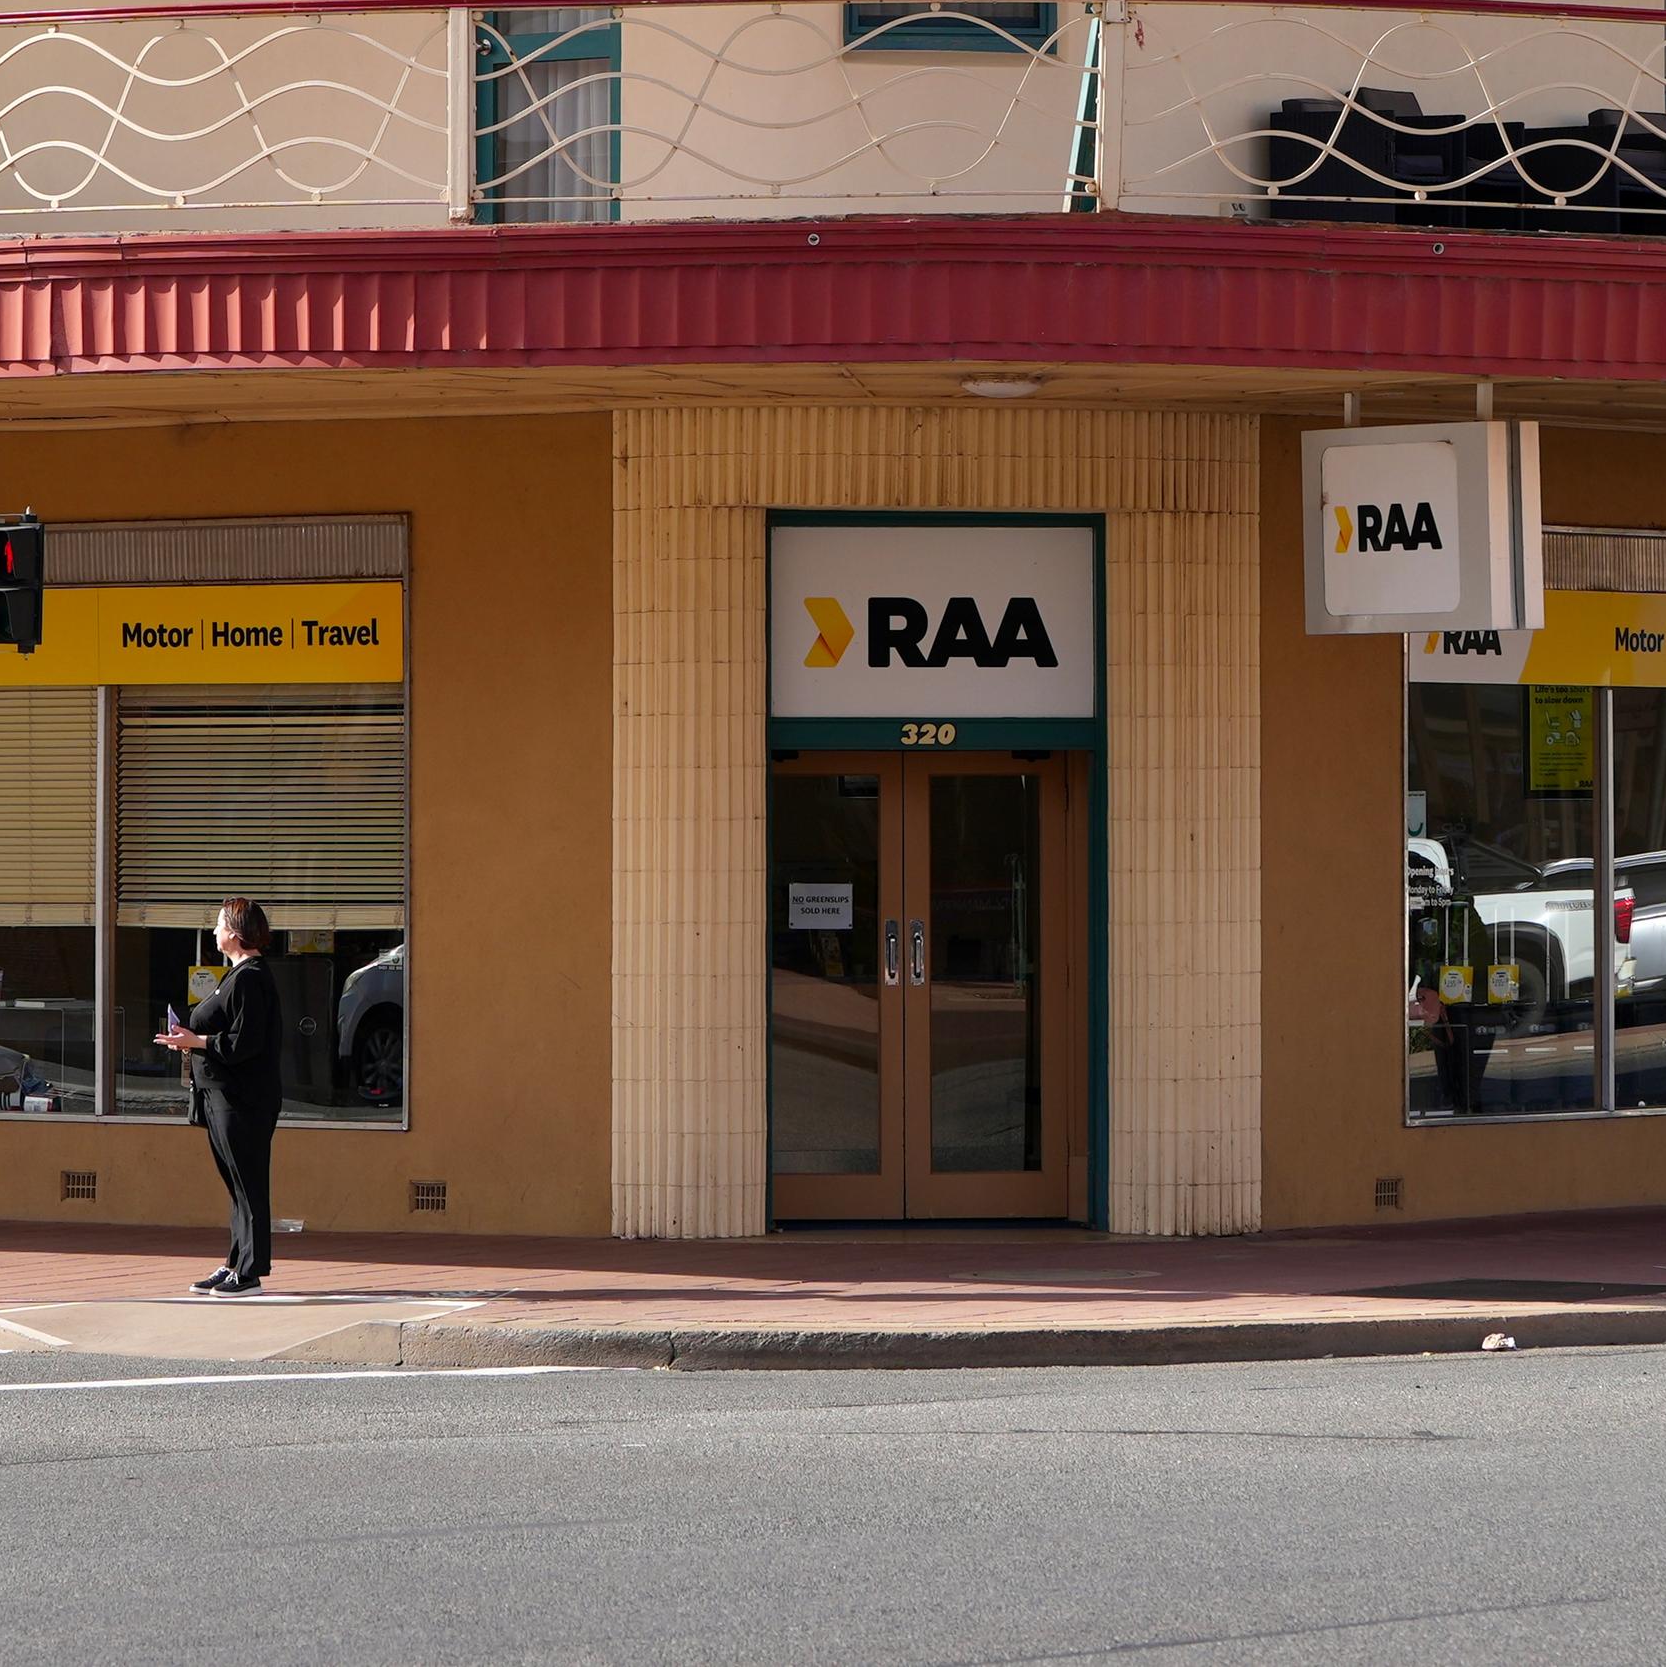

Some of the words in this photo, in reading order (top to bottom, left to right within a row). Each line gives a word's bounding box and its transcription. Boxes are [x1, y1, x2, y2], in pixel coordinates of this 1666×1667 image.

[1357, 502, 1442, 552] RAA
[122, 622, 193, 648] Motor
[212, 621, 283, 647] Home
[301, 618, 379, 646] Travel
[868, 597, 1059, 668] RAA
[1443, 630, 1502, 655] RAA
[1615, 627, 1664, 652] Motor
[900, 723, 956, 745] 320
[792, 896, 804, 904] NO
[805, 896, 849, 904] GREENSLIPS
[800, 907, 820, 915] SOLD
[821, 907, 840, 915] HERE
